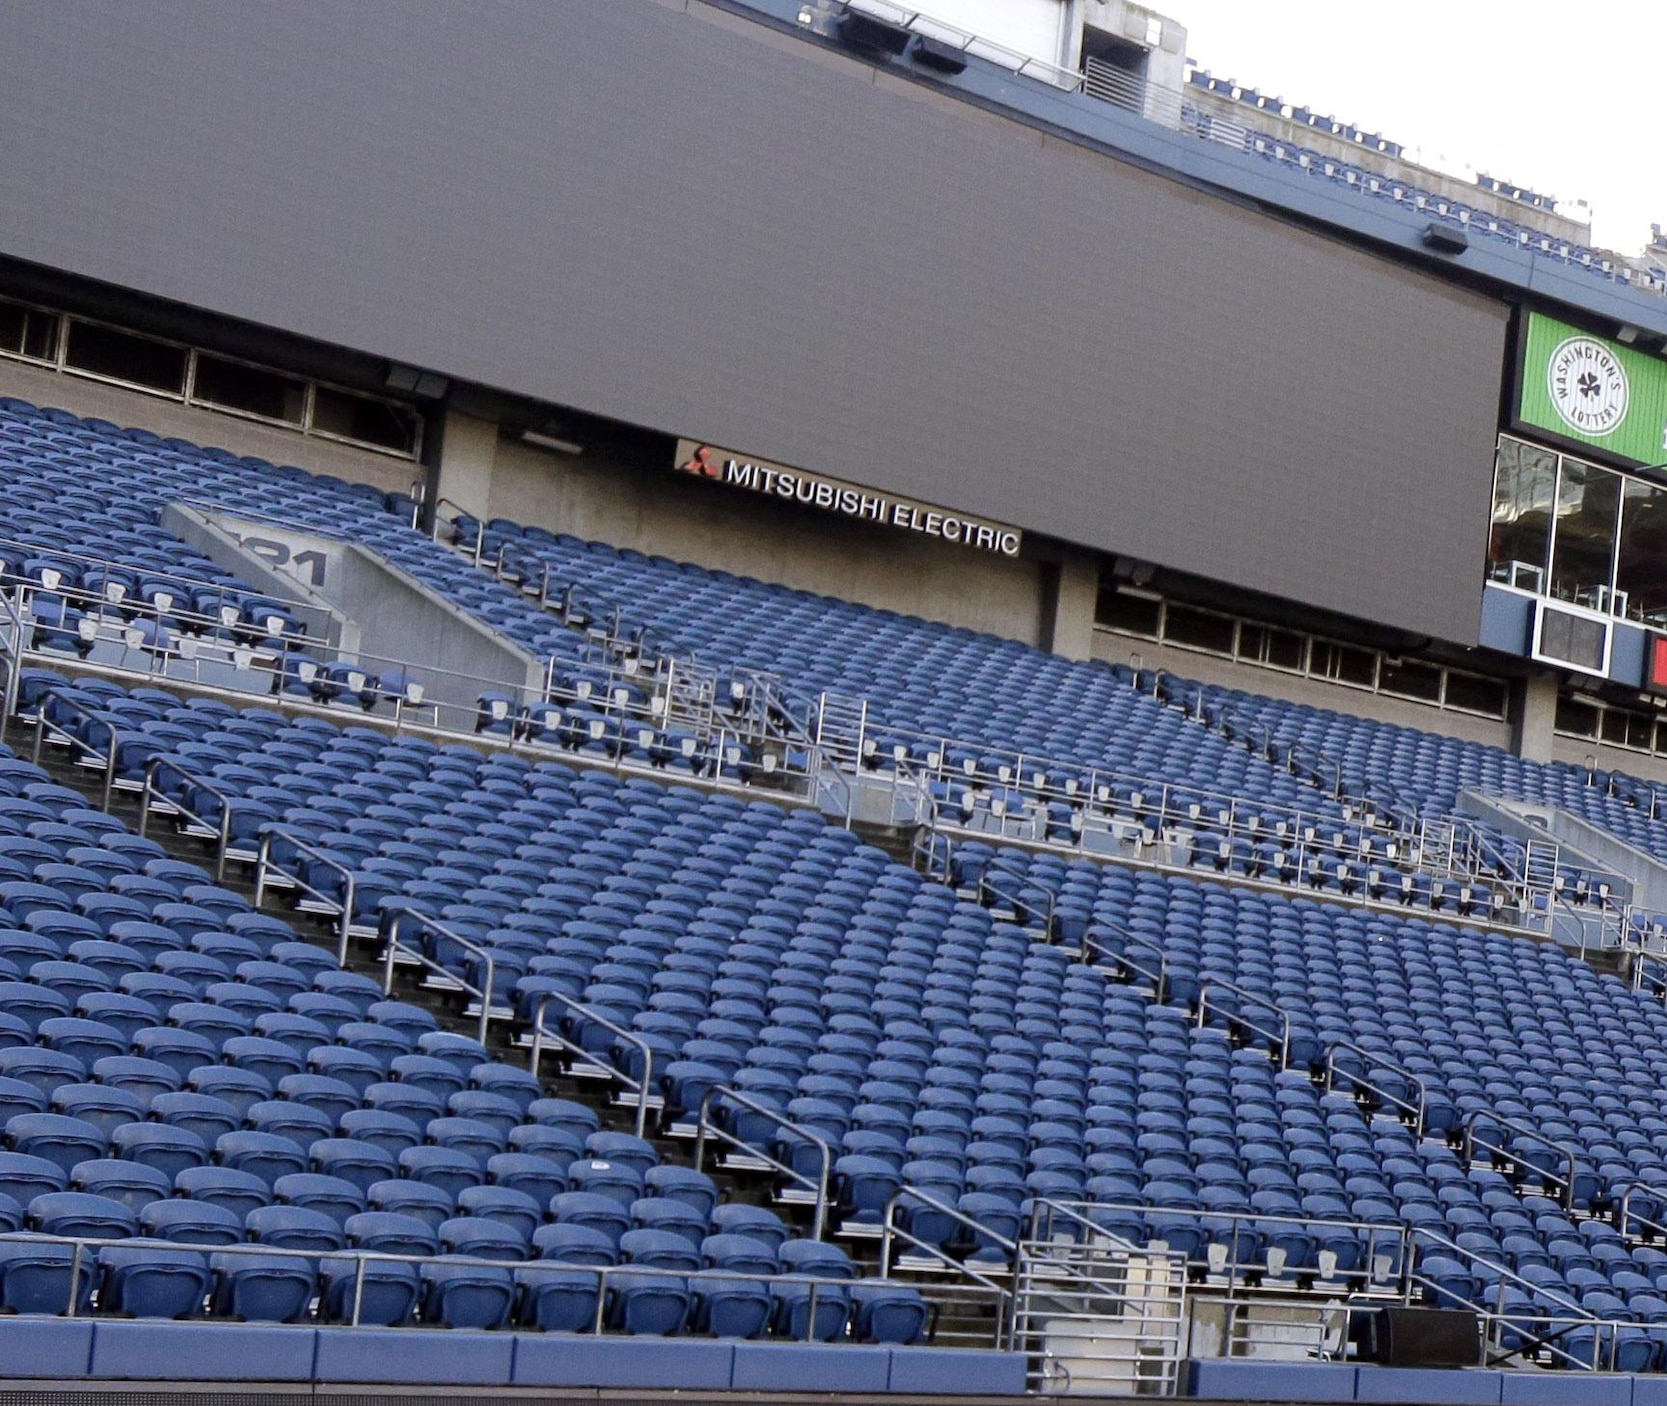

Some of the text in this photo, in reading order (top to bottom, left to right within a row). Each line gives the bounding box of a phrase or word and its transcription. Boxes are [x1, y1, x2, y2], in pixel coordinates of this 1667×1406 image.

[1556, 346, 1621, 399] WASHINGTON'S
[1571, 401, 1618, 426] LOTTERY
[726, 459, 1020, 556] MITSUBISHI ELECTRIC
[227, 531, 327, 587] 21
